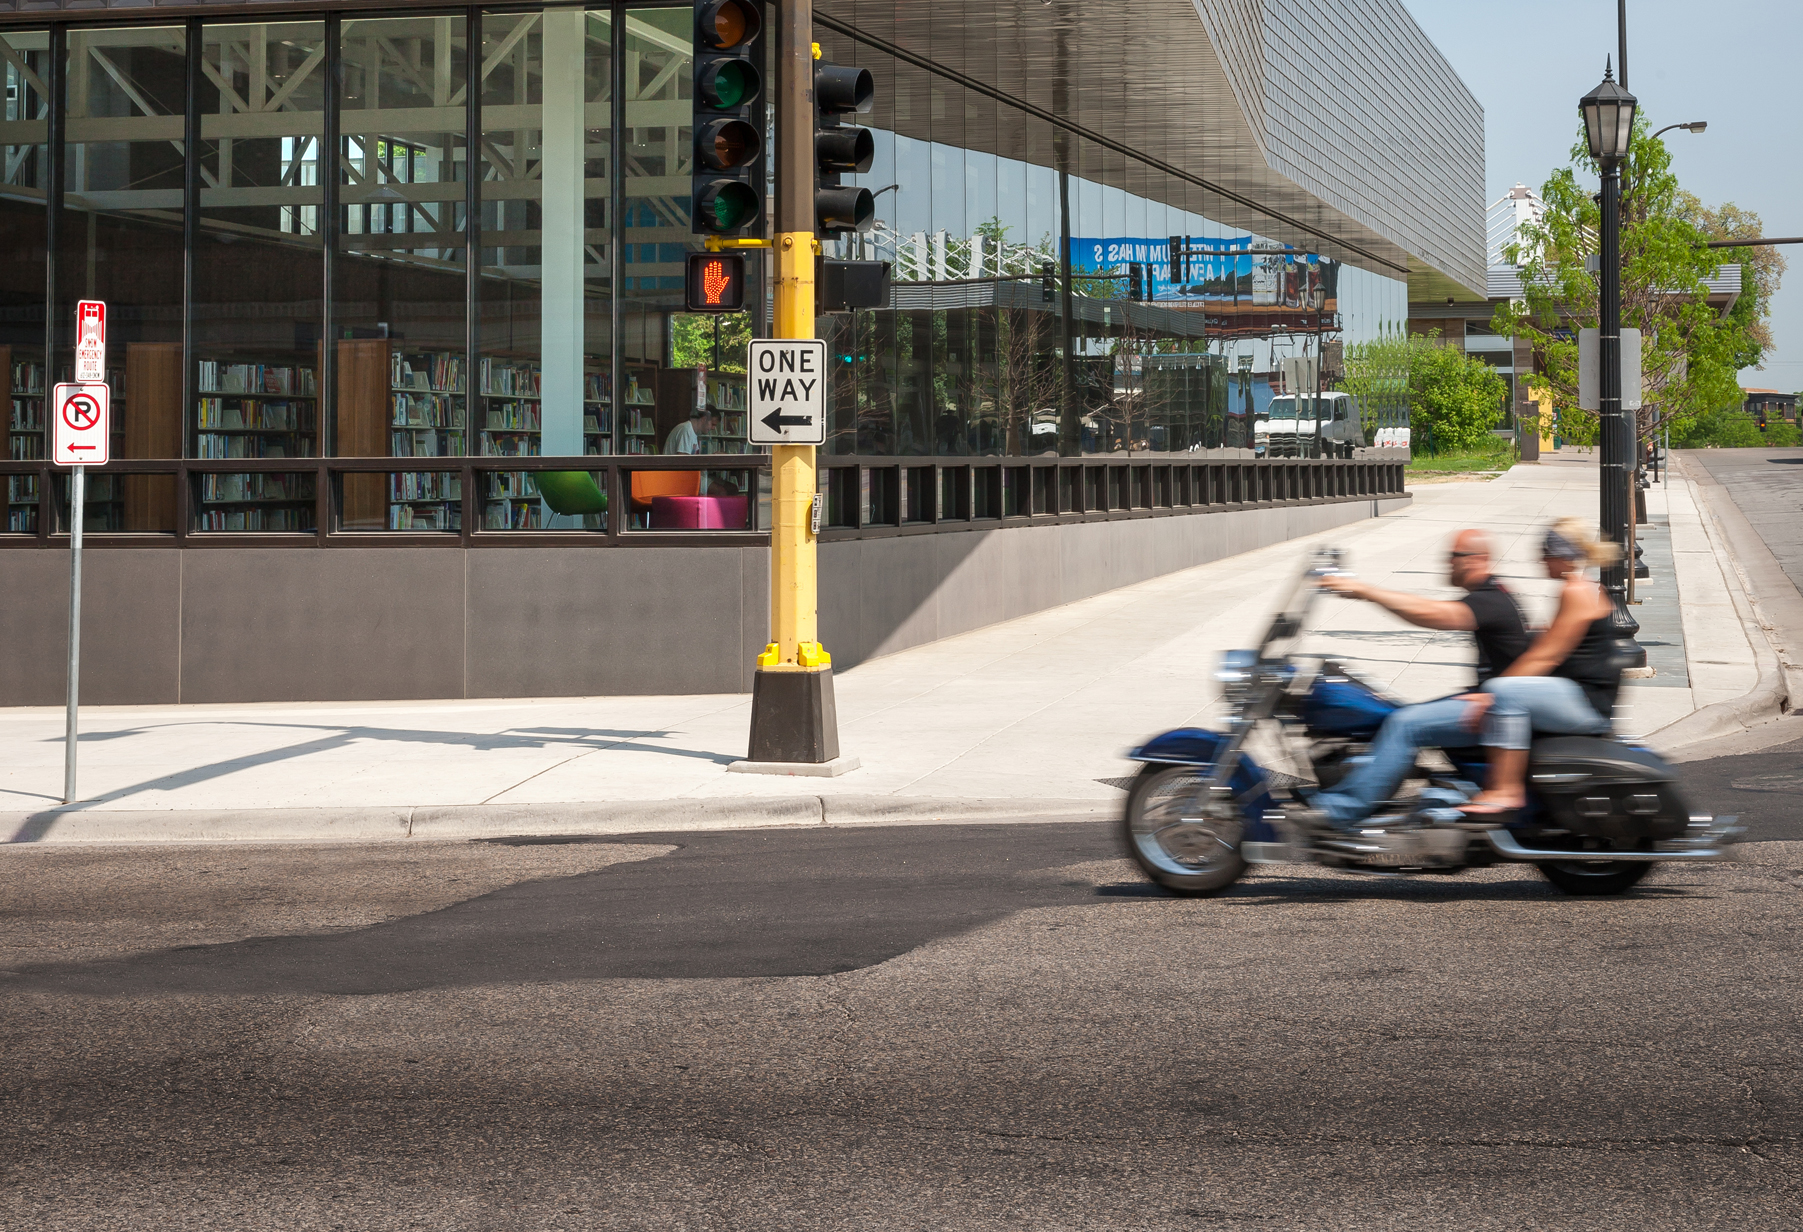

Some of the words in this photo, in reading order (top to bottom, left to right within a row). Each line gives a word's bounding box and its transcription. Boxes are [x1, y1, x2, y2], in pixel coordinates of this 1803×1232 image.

[84, 338, 97, 348] SNOW
[759, 349, 814, 373] ONE
[757, 378, 817, 402] WAY
